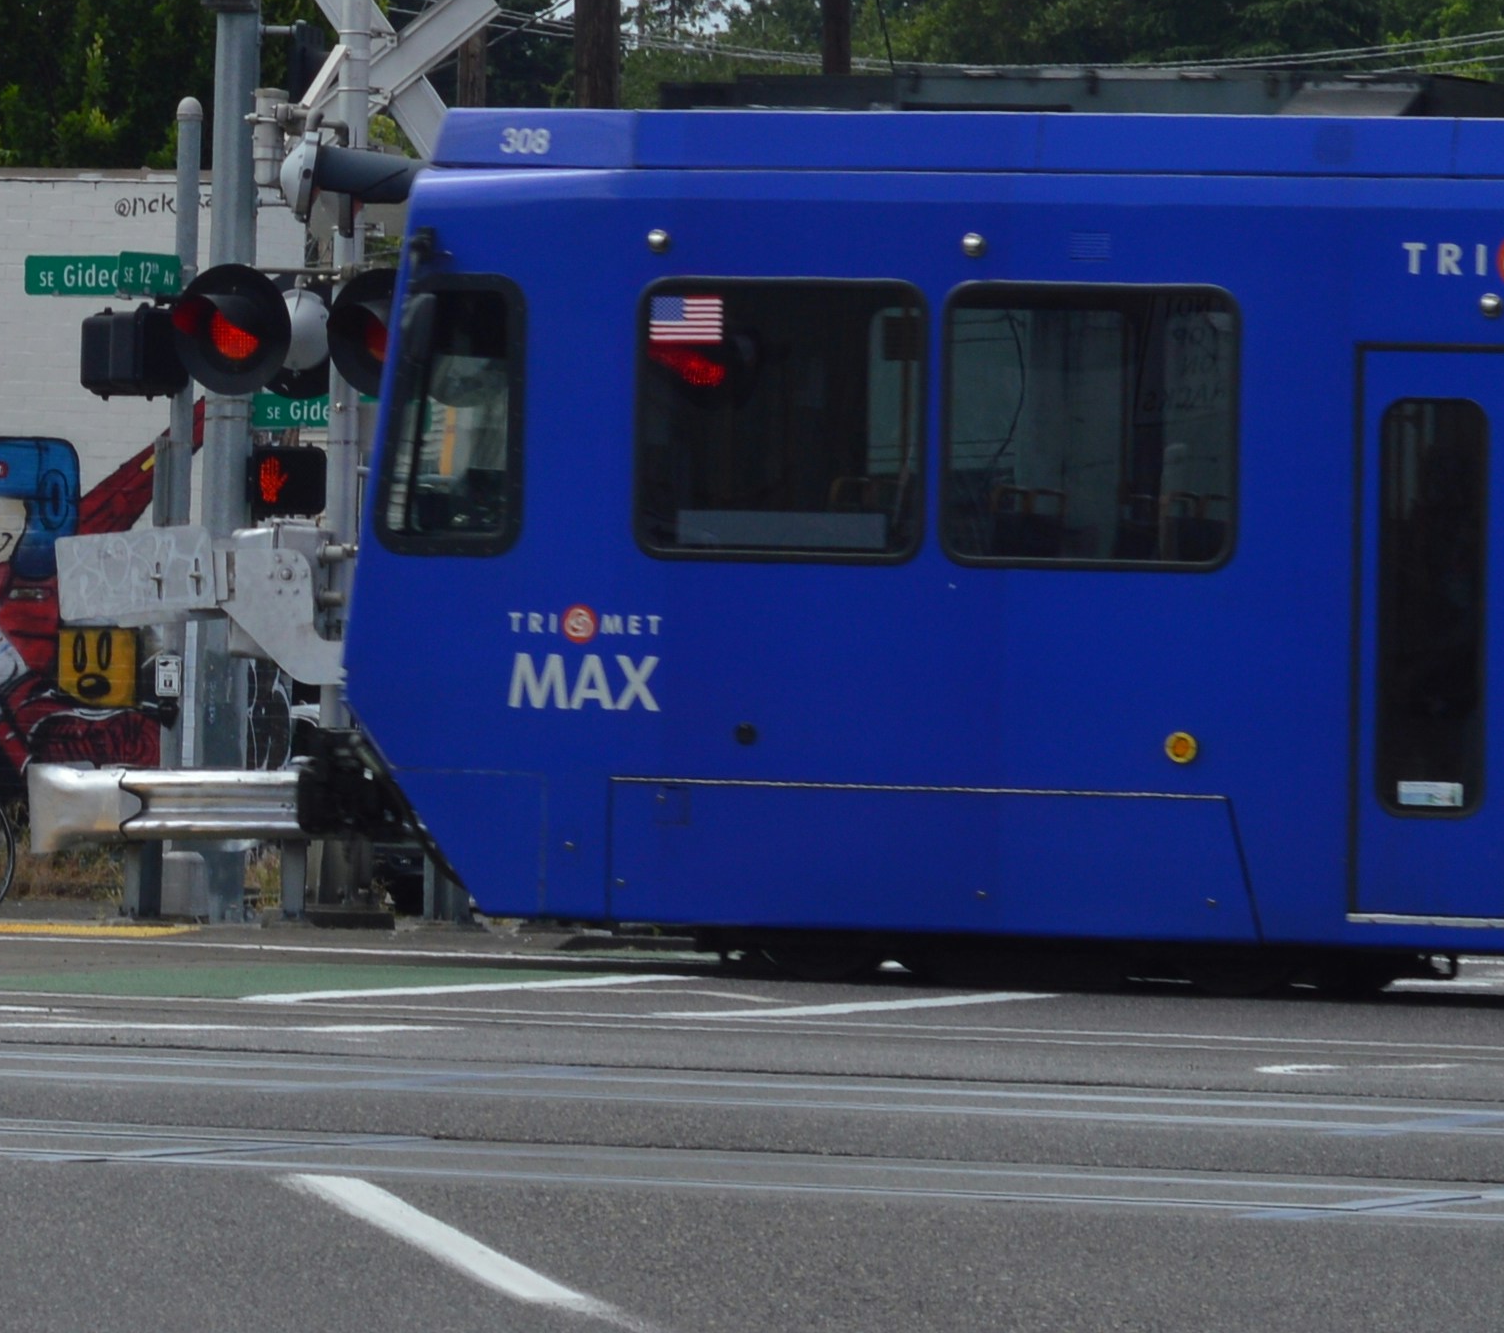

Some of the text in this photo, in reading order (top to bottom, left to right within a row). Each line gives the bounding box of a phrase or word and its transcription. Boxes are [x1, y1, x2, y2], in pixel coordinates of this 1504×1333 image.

[498, 127, 551, 155] 308
[39, 262, 119, 288] SE Gideo
[123, 261, 176, 287] SE 12th Av
[265, 400, 330, 421] SE Gide
[507, 652, 662, 713] MAX
